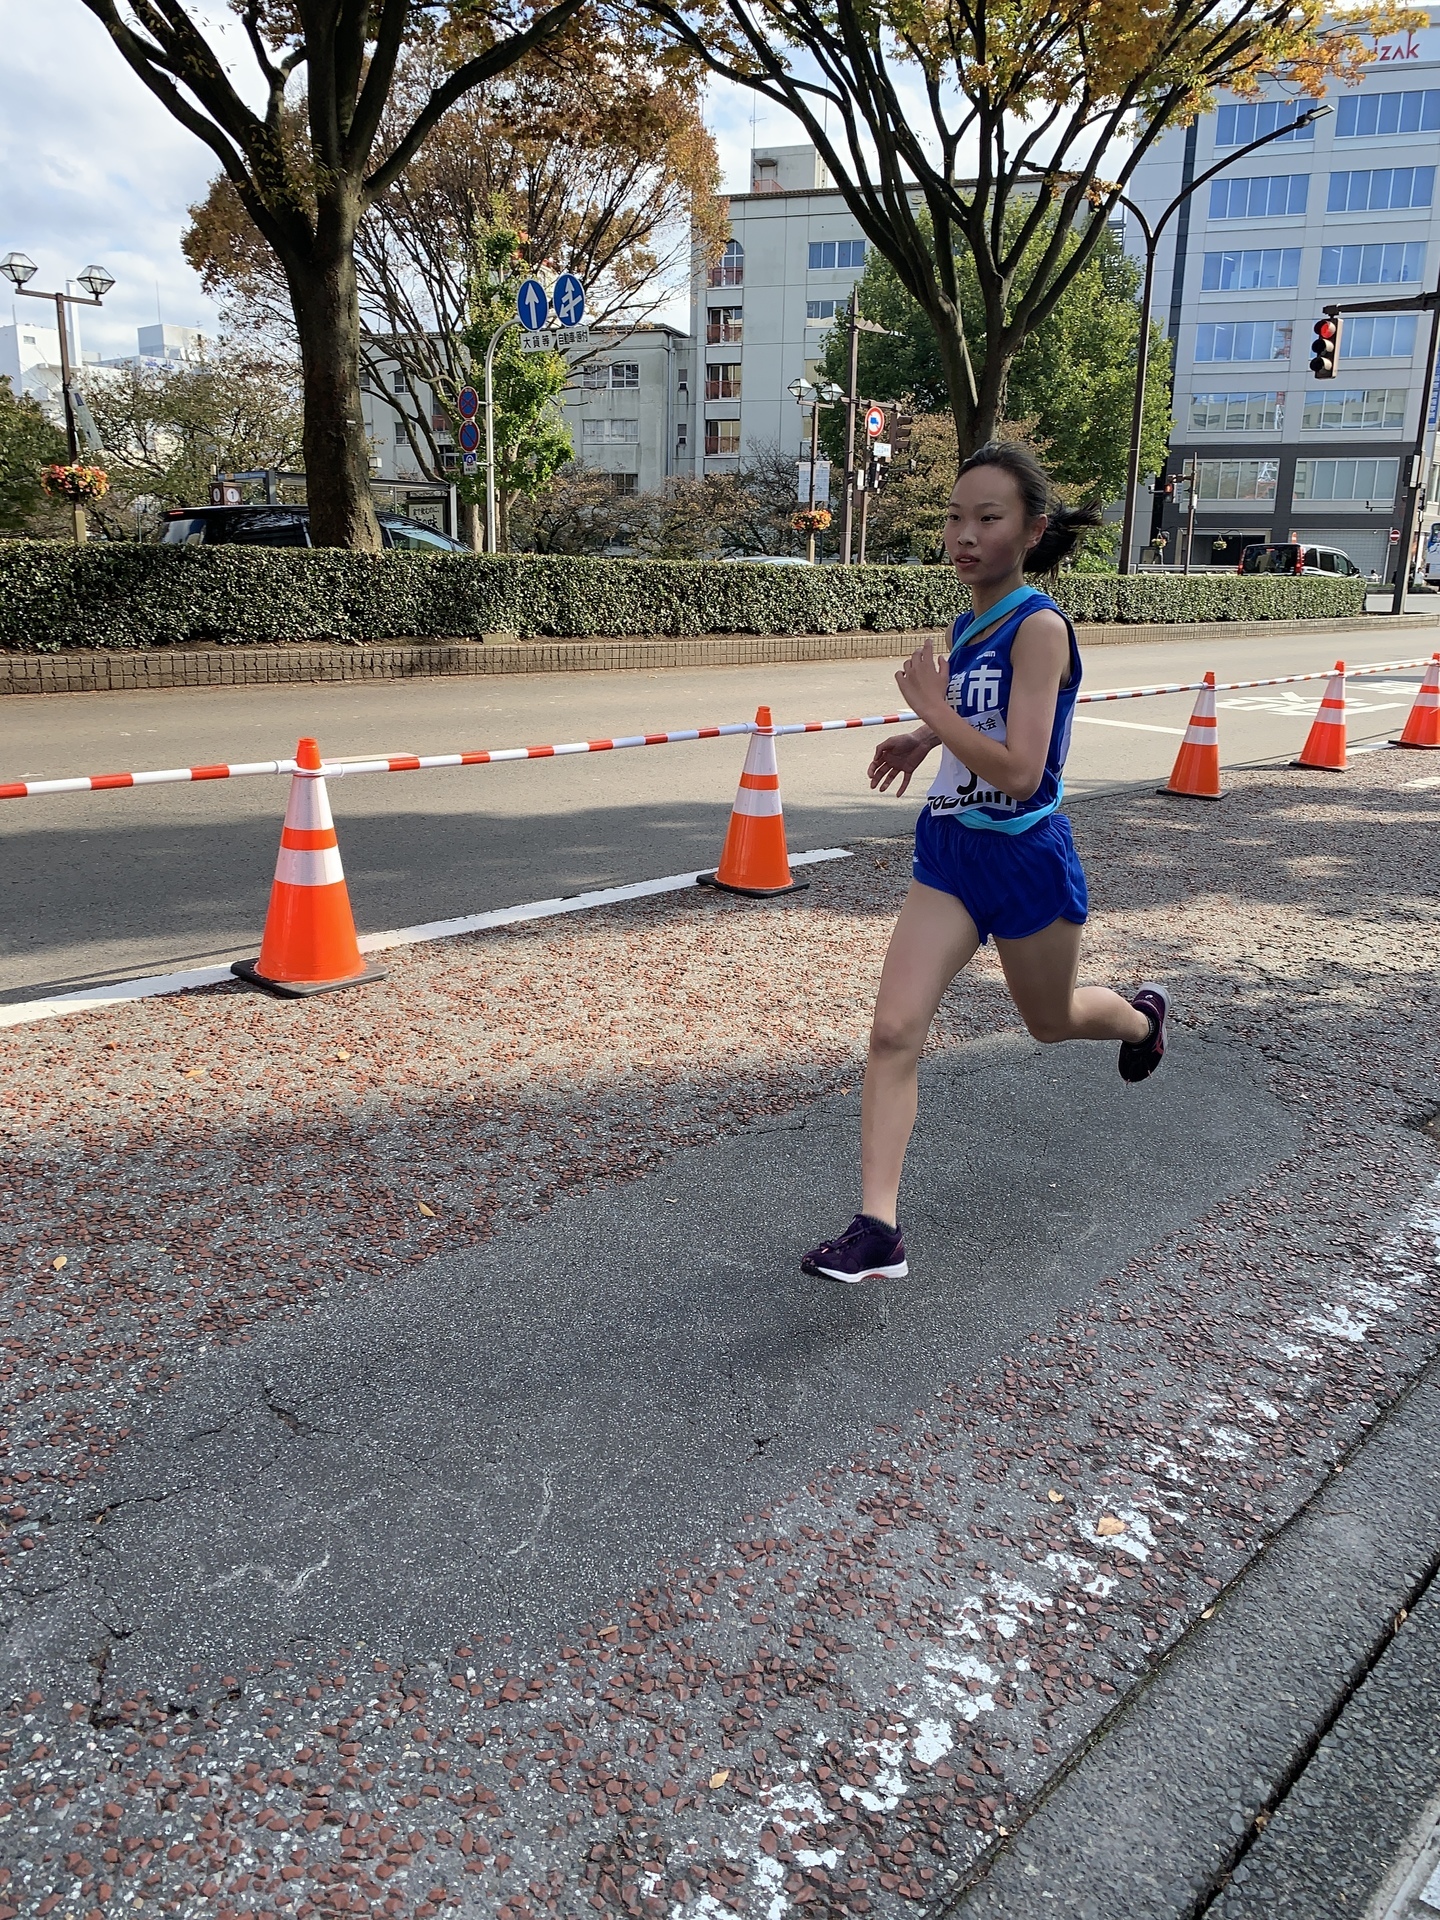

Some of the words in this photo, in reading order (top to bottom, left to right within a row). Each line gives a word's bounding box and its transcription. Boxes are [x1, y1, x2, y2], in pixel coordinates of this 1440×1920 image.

[523, 335, 550, 349] 大貨等
[970, 717, 997, 732] 大会
